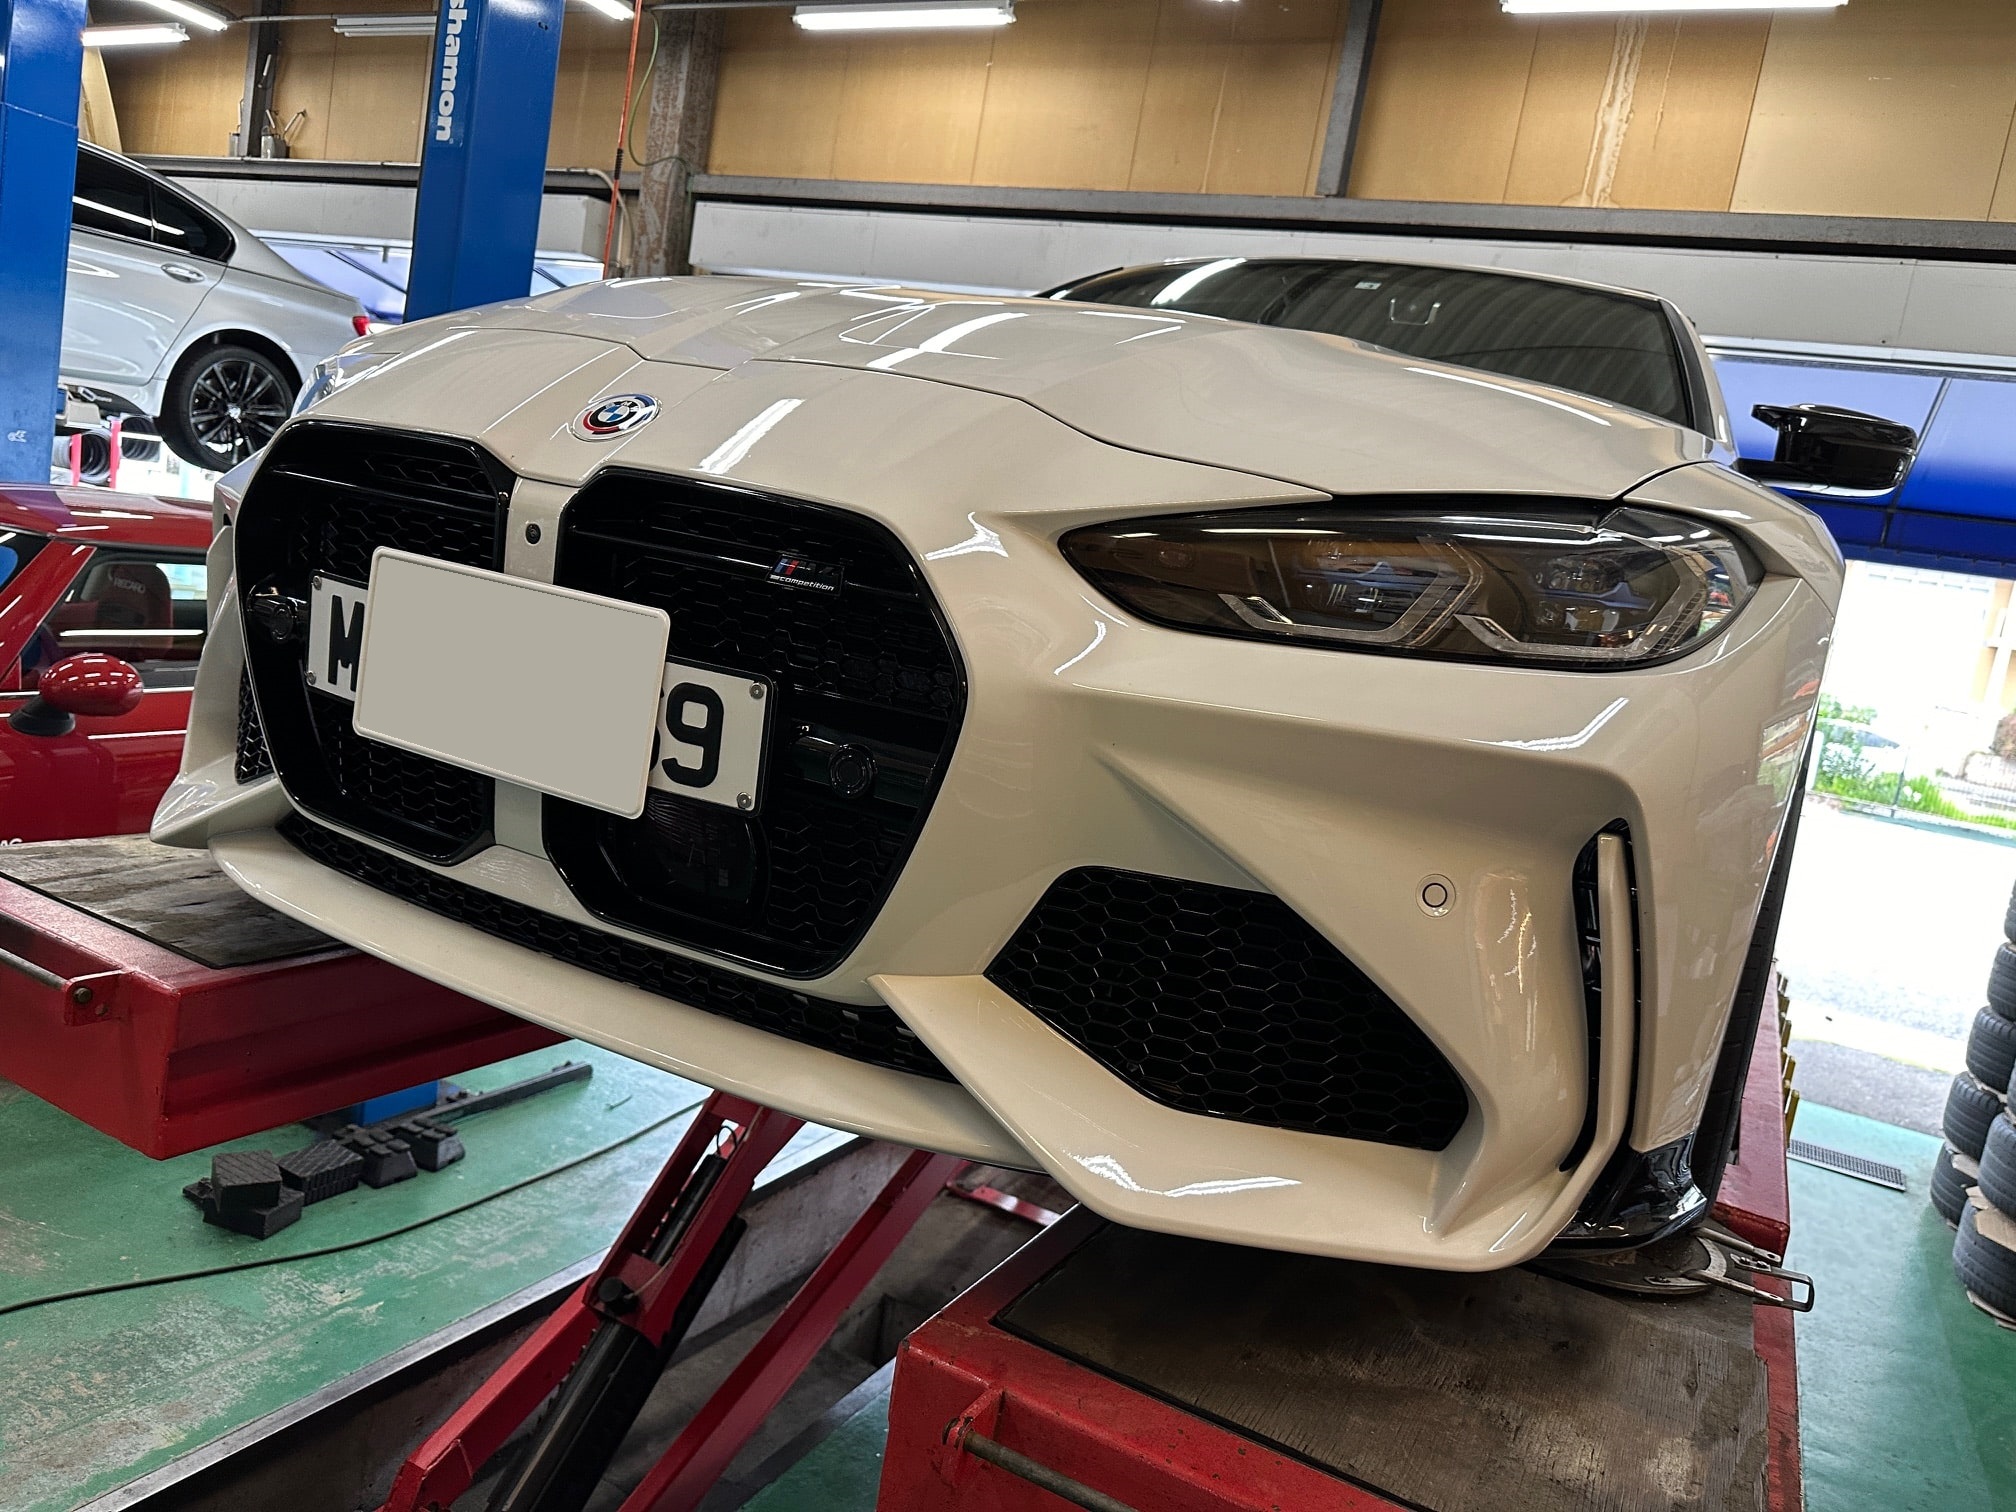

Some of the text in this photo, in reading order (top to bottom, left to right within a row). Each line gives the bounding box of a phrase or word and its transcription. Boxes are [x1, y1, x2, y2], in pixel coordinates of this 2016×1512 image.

[778, 576, 835, 592] competition
[328, 594, 724, 788] M 9
